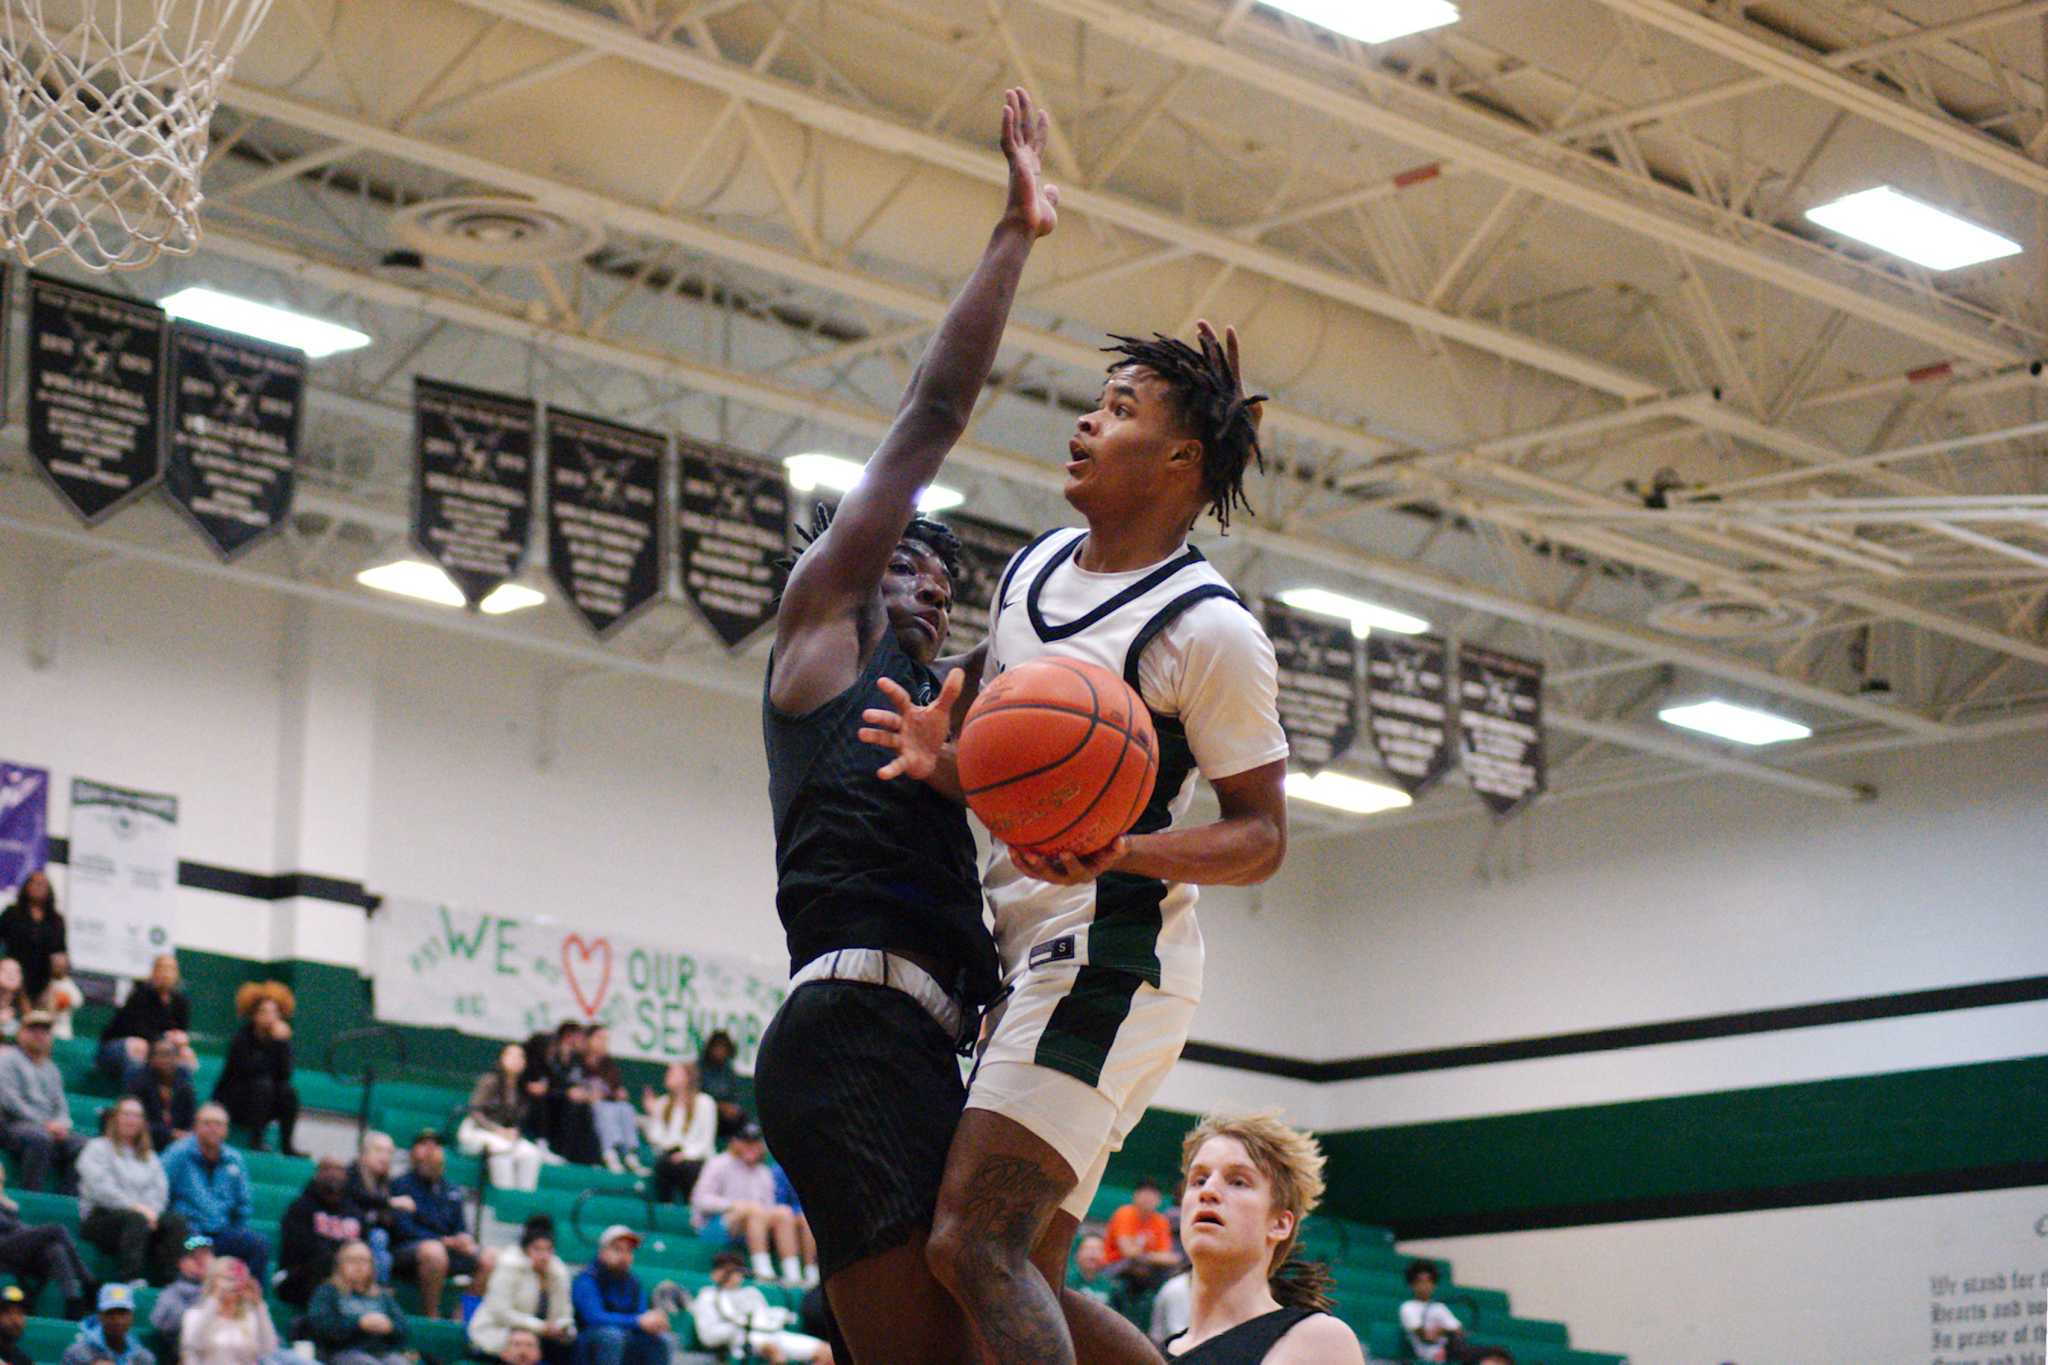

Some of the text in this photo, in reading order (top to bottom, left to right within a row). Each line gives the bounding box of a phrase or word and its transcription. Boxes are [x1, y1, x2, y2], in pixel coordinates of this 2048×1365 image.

[438, 905, 520, 976] WE
[1059, 942, 1067, 953] S
[628, 948, 697, 999] OUR
